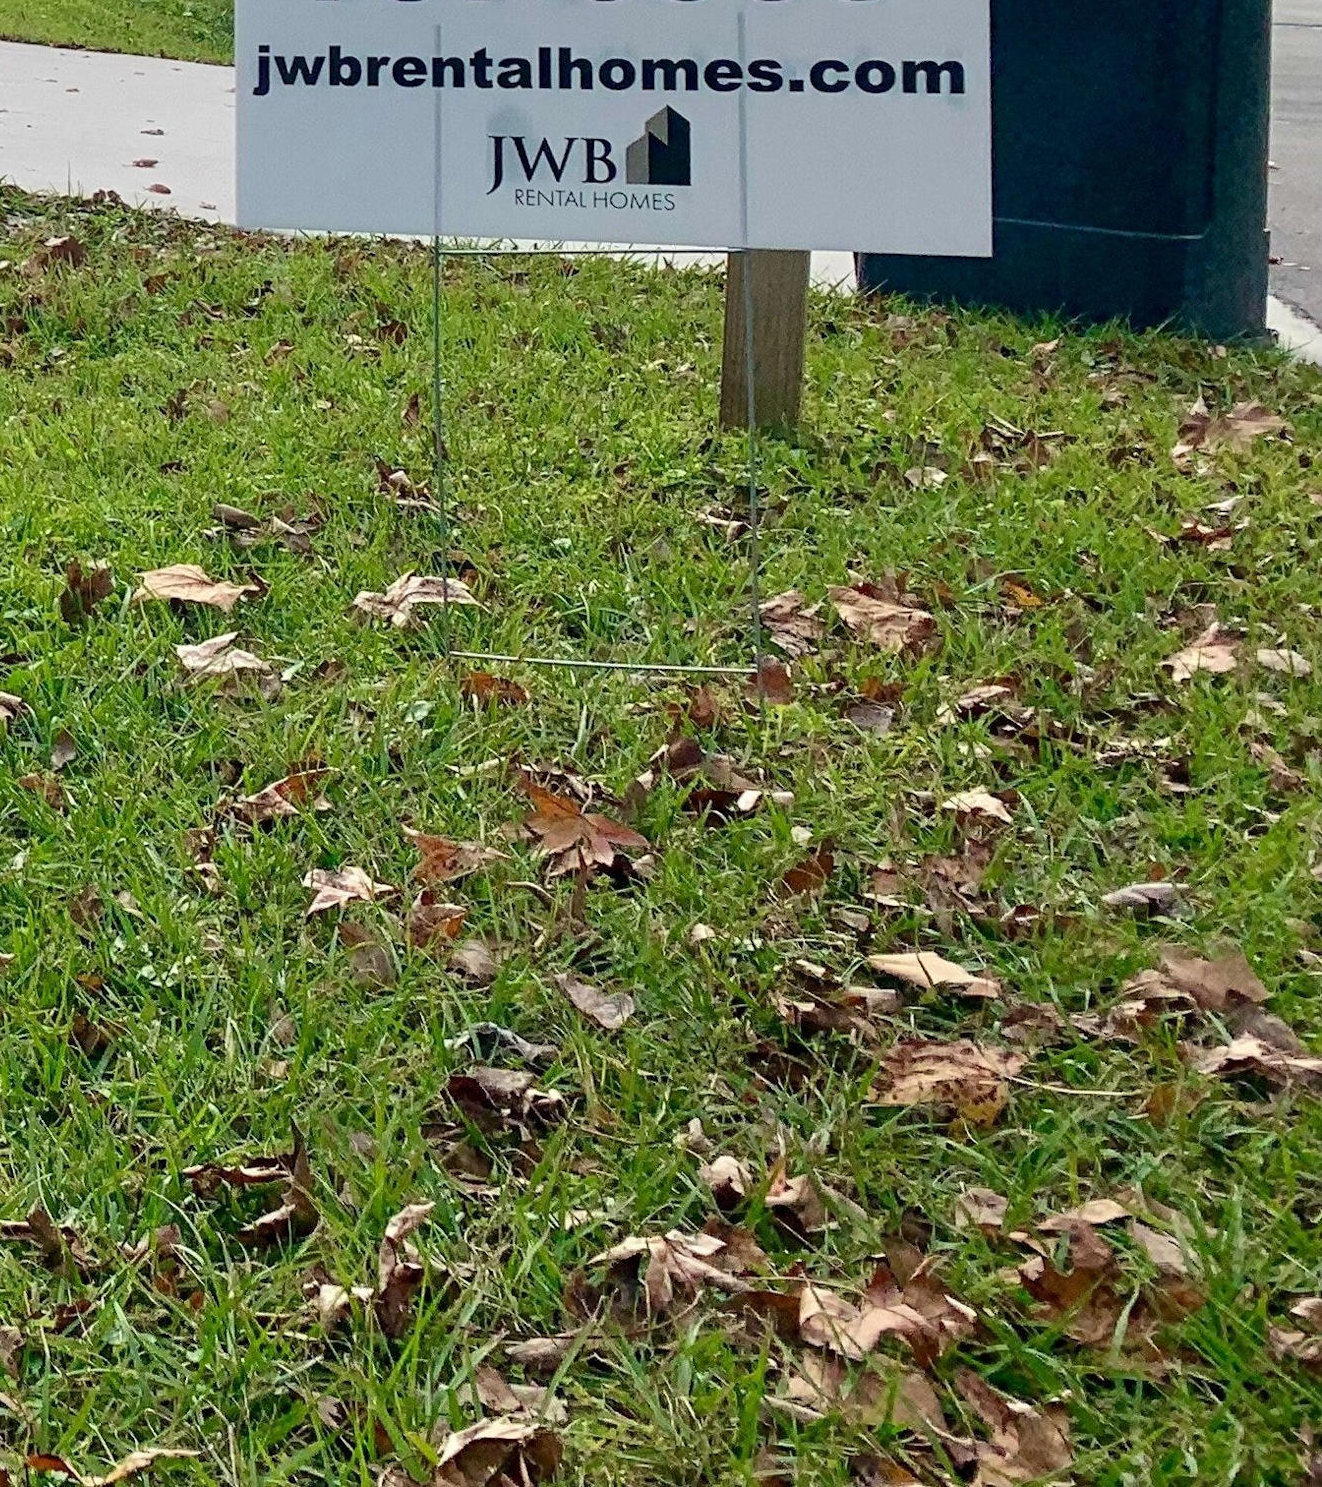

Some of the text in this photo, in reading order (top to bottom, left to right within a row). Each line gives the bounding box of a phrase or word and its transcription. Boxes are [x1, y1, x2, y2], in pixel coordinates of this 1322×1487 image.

[253, 44, 965, 96] jwbrentalhomes.com
[486, 134, 617, 195] JWB
[515, 188, 676, 211] RENTAL HOMES
